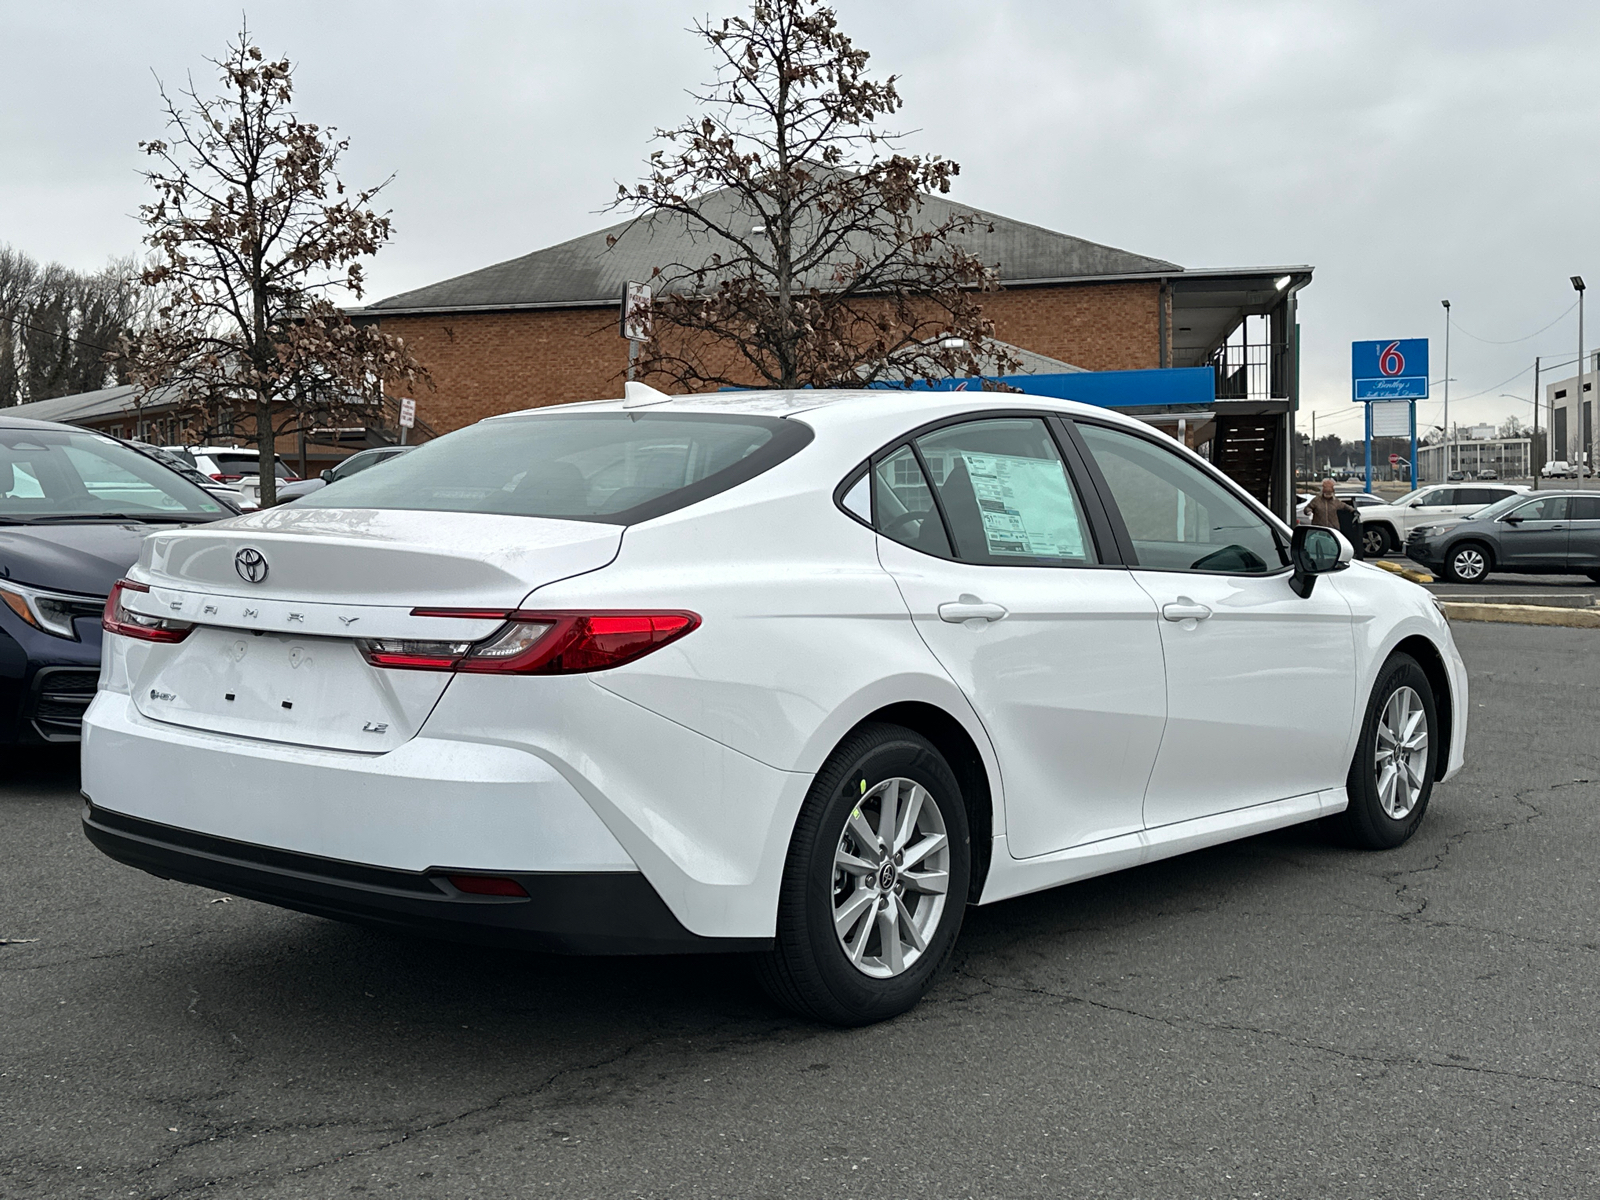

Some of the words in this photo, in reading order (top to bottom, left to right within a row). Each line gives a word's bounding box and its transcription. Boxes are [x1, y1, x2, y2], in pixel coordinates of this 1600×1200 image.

[1379, 341, 1405, 376] 6
[169, 601, 360, 626] CAMRY
[362, 721, 389, 734] LE
